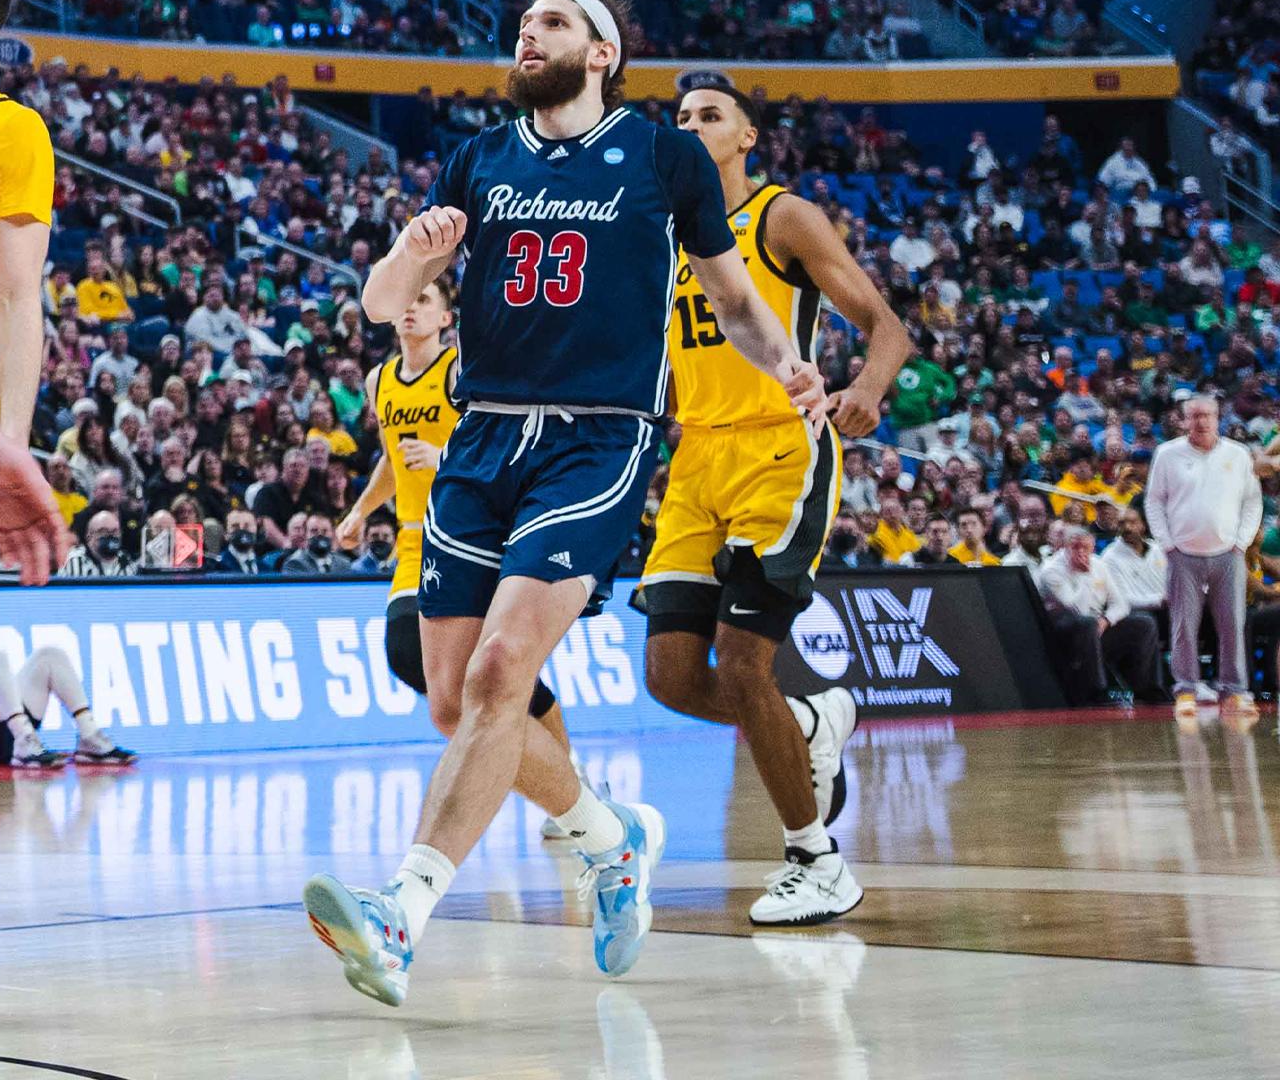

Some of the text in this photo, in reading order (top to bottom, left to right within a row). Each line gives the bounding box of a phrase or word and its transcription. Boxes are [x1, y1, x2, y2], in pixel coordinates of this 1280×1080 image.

[483, 184, 626, 224] Richmond
[504, 230, 588, 307] 33
[675, 293, 727, 350] 15
[381, 401, 441, 429] Iowa
[802, 633, 848, 653] NCAA
[865, 623, 923, 643] TITLE
[865, 687, 952, 707] Anniversary
